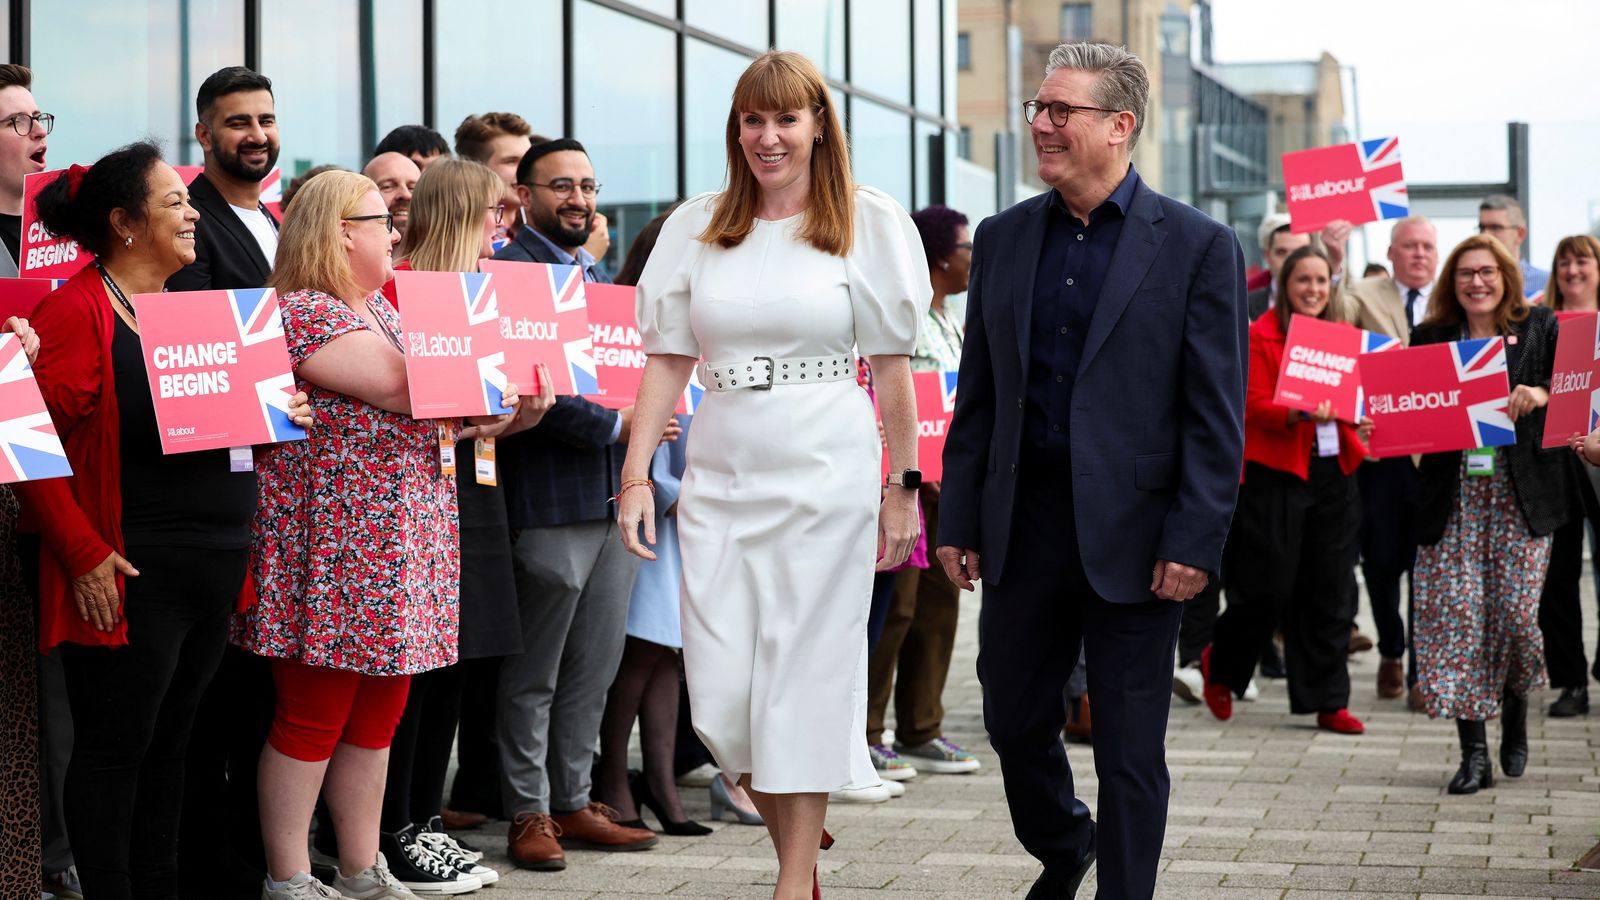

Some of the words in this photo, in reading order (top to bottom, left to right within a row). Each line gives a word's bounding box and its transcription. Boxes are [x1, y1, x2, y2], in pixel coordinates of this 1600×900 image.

[1306, 177, 1367, 200] Labour
[26, 241, 79, 270] BEGINS
[507, 317, 558, 340] Labour
[588, 324, 642, 346] HAN
[153, 342, 238, 370] CHANGE
[422, 332, 472, 356] Labour
[1289, 345, 1357, 374] CHANGE
[159, 371, 230, 399] BEGINS
[1285, 361, 1342, 387] BEGINS
[1560, 370, 1592, 393] Labour
[1388, 389, 1461, 413] Labour
